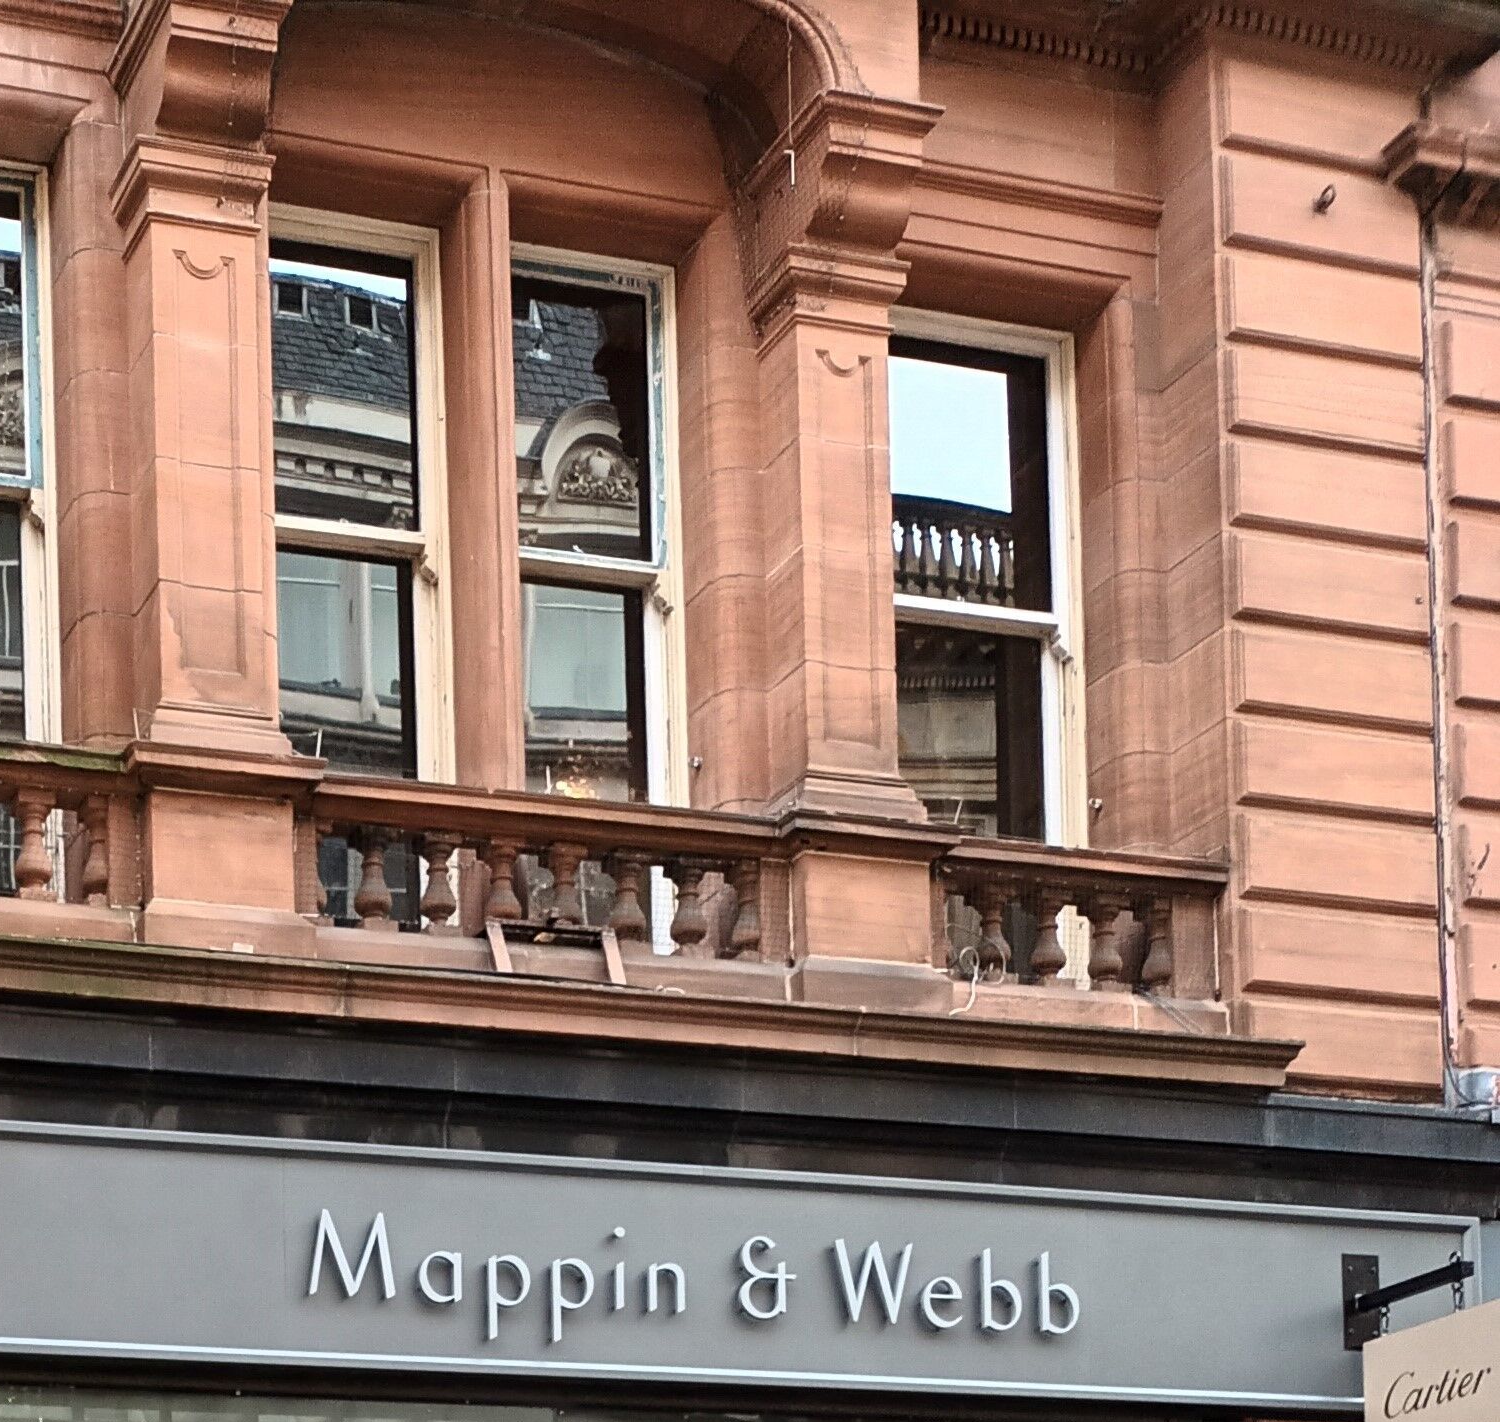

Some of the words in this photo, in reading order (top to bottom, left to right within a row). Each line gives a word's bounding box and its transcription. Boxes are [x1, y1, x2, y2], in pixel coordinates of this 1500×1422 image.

[307, 1208, 687, 1342] Mappin
[738, 1235, 797, 1320] &
[833, 1237, 1081, 1335] Webb
[1383, 1367, 1492, 1420] Cartier
